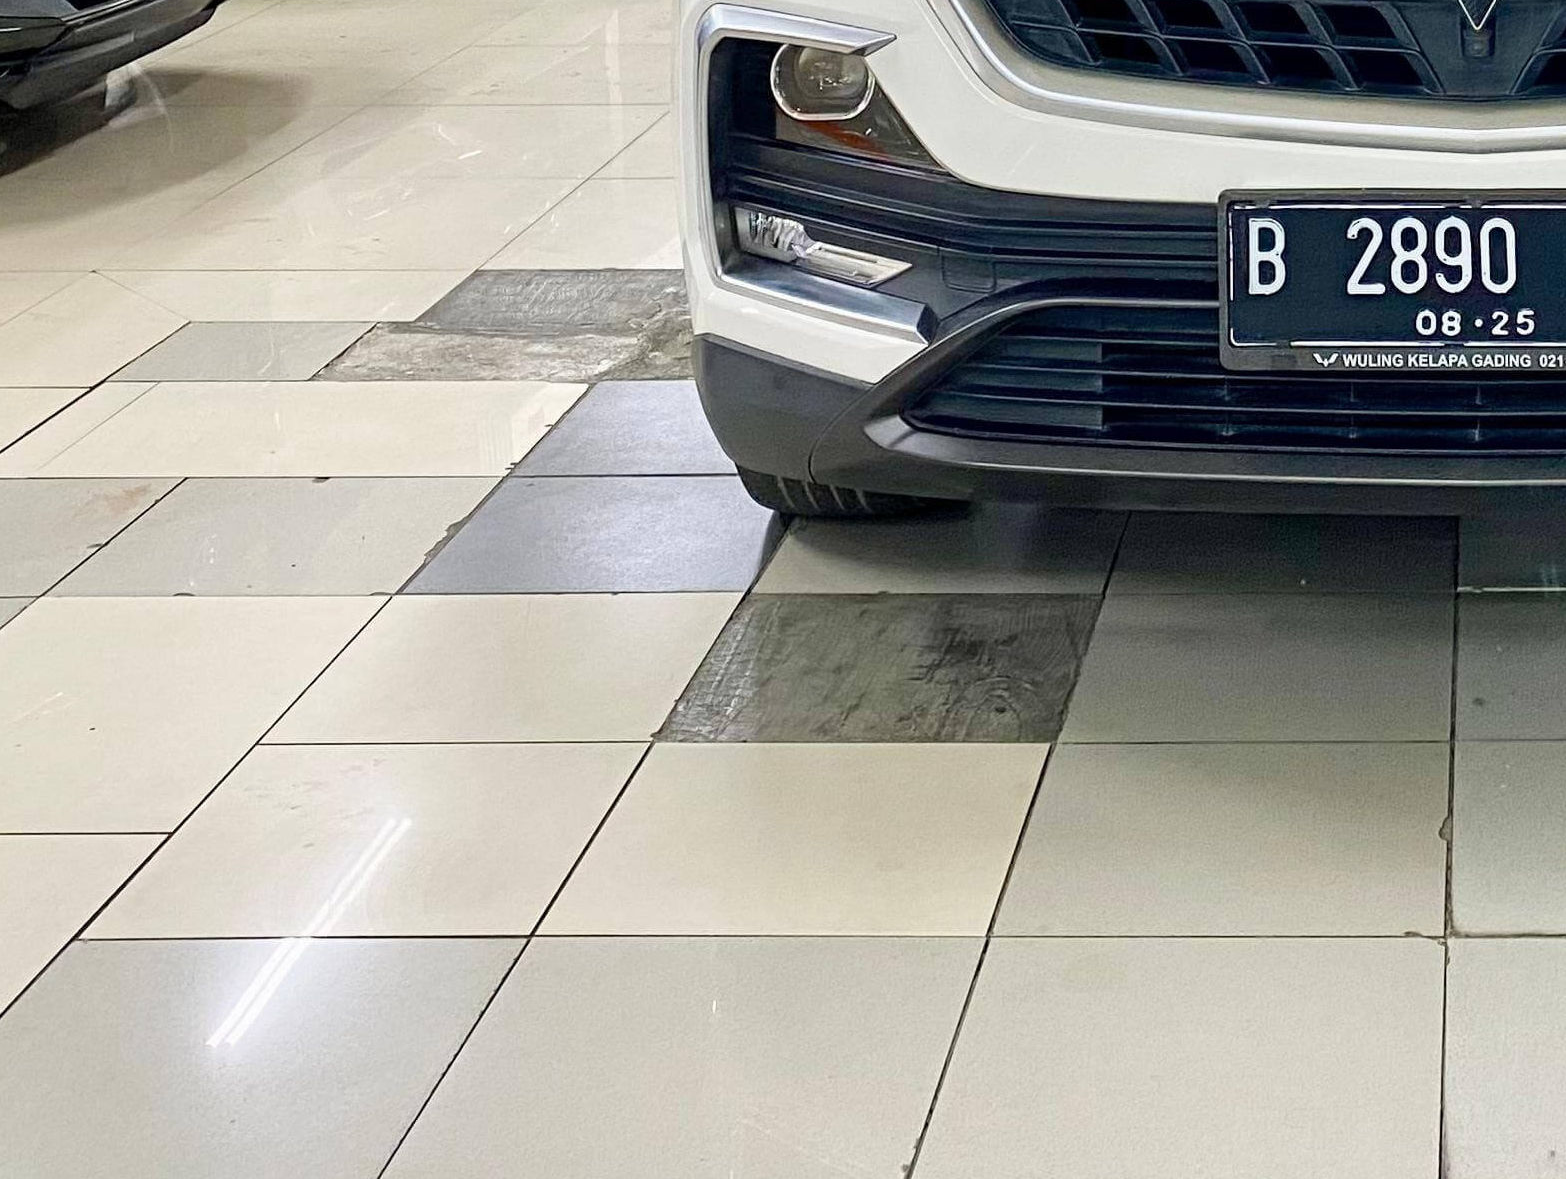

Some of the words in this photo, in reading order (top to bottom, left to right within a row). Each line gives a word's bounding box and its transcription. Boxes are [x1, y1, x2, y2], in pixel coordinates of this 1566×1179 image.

[1249, 217, 1286, 295] B
[1347, 215, 1517, 295] 2890
[1343, 353, 1403, 368] WULING
[1407, 353, 1468, 368] KELAPA
[1471, 353, 1532, 368] GADING
